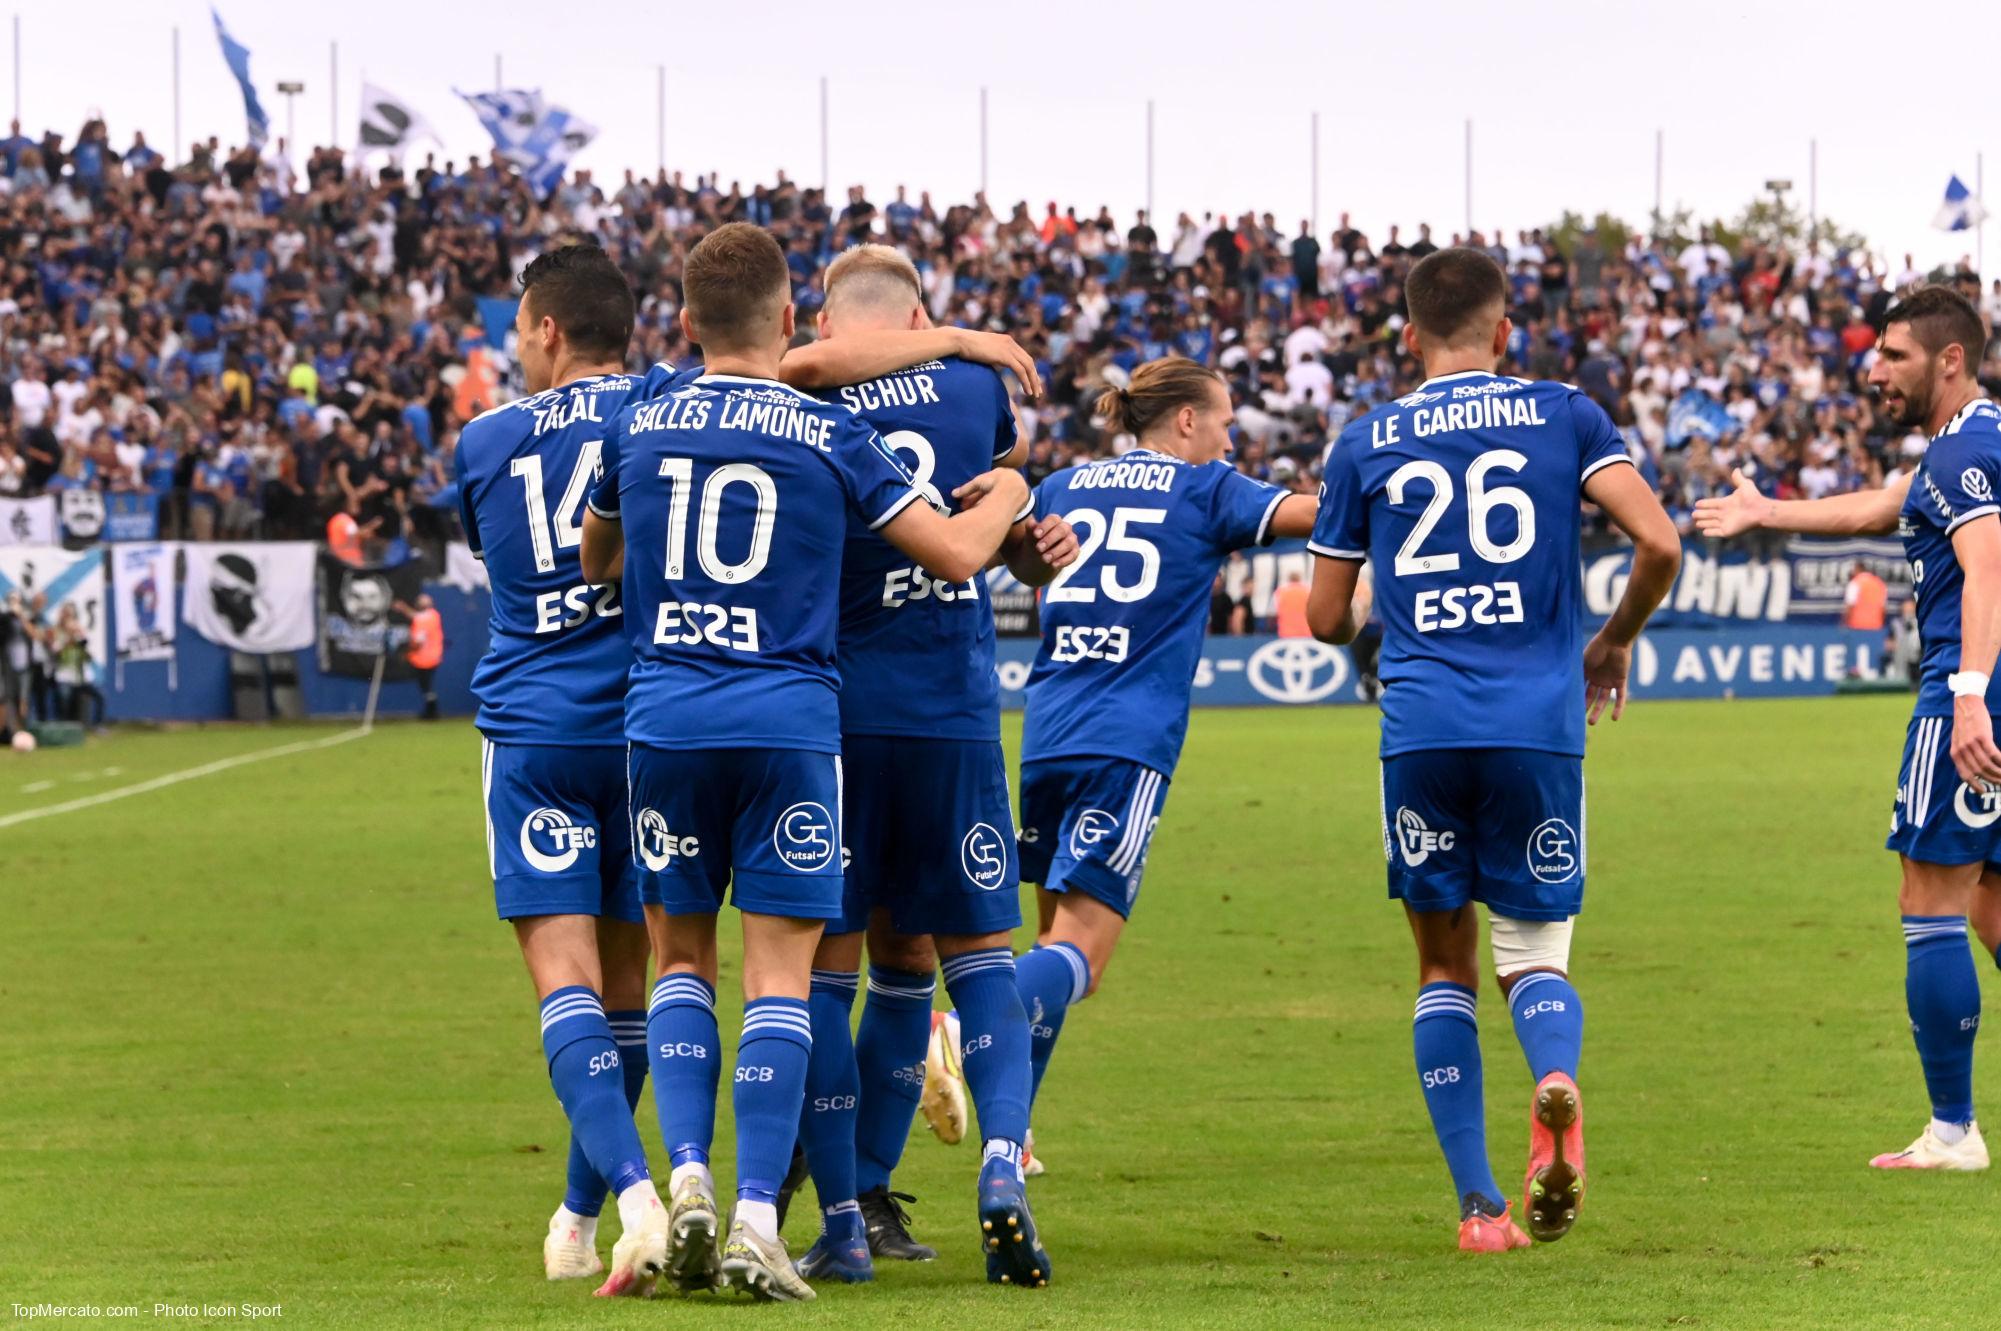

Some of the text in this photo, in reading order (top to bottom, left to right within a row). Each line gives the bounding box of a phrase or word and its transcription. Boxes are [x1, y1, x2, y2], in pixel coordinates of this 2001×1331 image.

[840, 374, 940, 415] SCHUR
[533, 395, 603, 436] TALAL
[629, 400, 836, 453] SALLES LAMONGE
[1372, 414, 1400, 449] LE
[1068, 463, 1176, 493] DUCROCQ
[511, 440, 604, 574] 14
[1386, 449, 1536, 577] 26
[658, 458, 778, 585] 10
[1045, 507, 1167, 604] 25
[1673, 644, 1878, 682] AVENEL
[549, 826, 596, 850] TEC
[653, 829, 700, 857] TEC
[1406, 828, 1456, 851] TEC
[785, 850, 816, 861] Futsal
[1536, 864, 1561, 874] Futsal
[1524, 1000, 1566, 1020] SCB
[1960, 1015, 1980, 1031] SC
[1030, 1023, 1053, 1039] CB
[589, 1049, 619, 1077] SCB
[660, 1042, 707, 1060] SCB
[734, 1066, 775, 1083] SCB
[892, 1069, 924, 1087] adid
[1423, 1066, 1461, 1089] SCB
[814, 1095, 857, 1113] SCB
